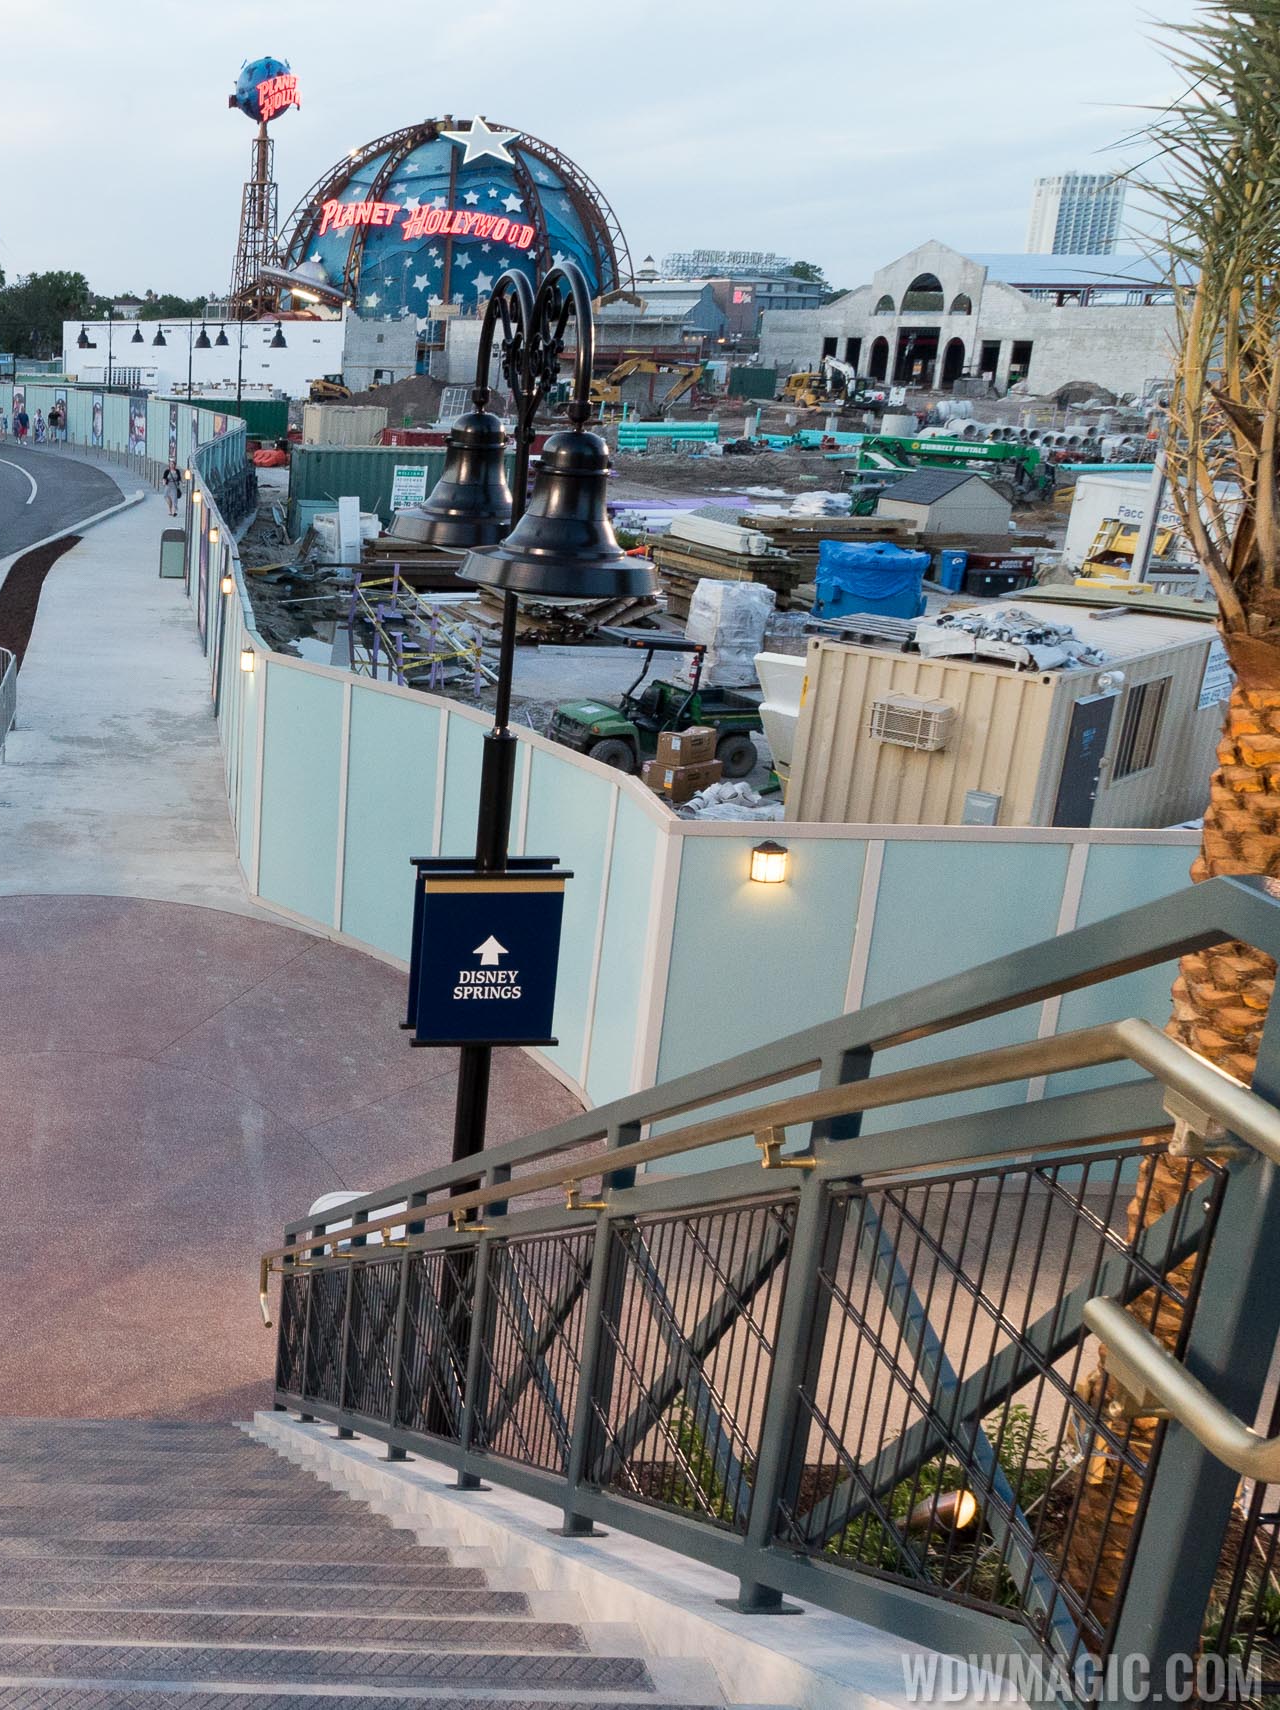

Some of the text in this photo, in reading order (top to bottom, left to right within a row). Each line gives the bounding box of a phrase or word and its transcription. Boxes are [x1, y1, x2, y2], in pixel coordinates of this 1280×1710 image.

[256, 74, 299, 106] PLANET
[319, 198, 536, 249] PLANET HOLLYWOOD
[458, 970, 519, 984] DISNEY
[453, 986, 522, 1000] SPRINGS
